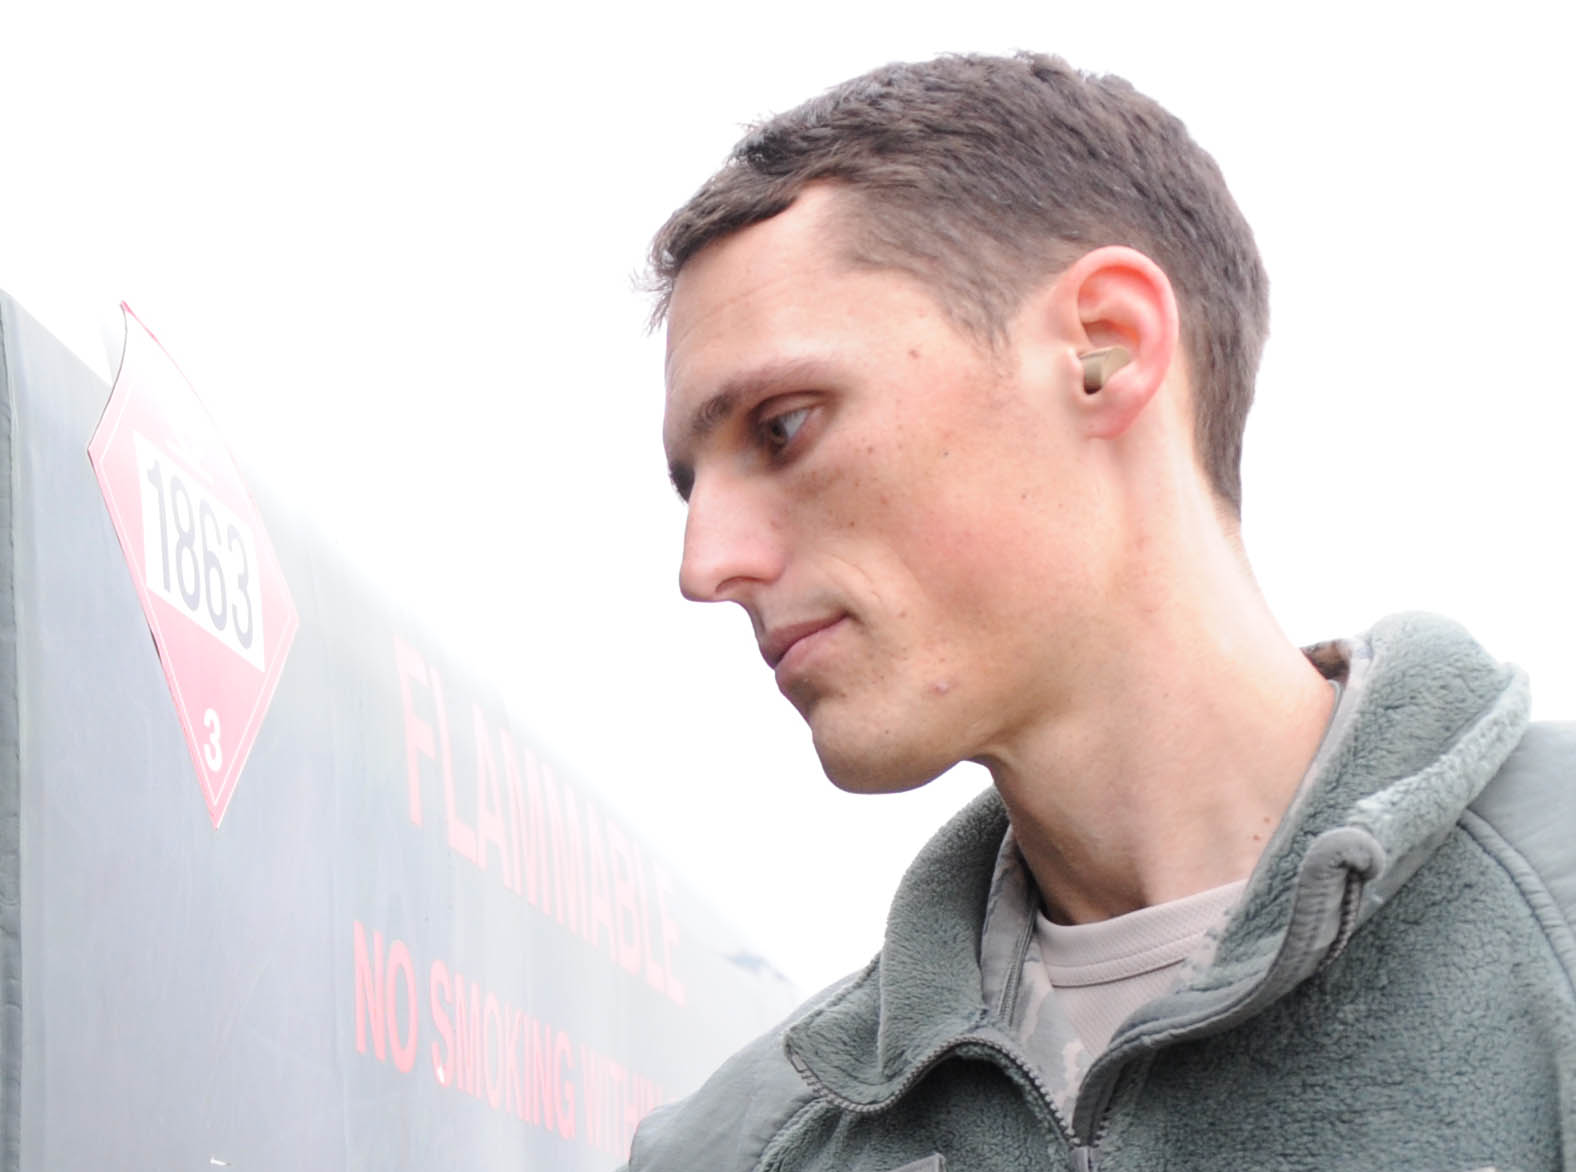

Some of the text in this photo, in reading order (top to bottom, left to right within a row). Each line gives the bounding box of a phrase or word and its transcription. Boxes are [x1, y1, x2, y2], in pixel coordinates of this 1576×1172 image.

[147, 459, 255, 651] 1863
[202, 707, 223, 774] 3
[393, 633, 686, 1007] FLAMMABLE
[353, 920, 419, 1074] NO
[429, 959, 575, 1141] SMOKING
